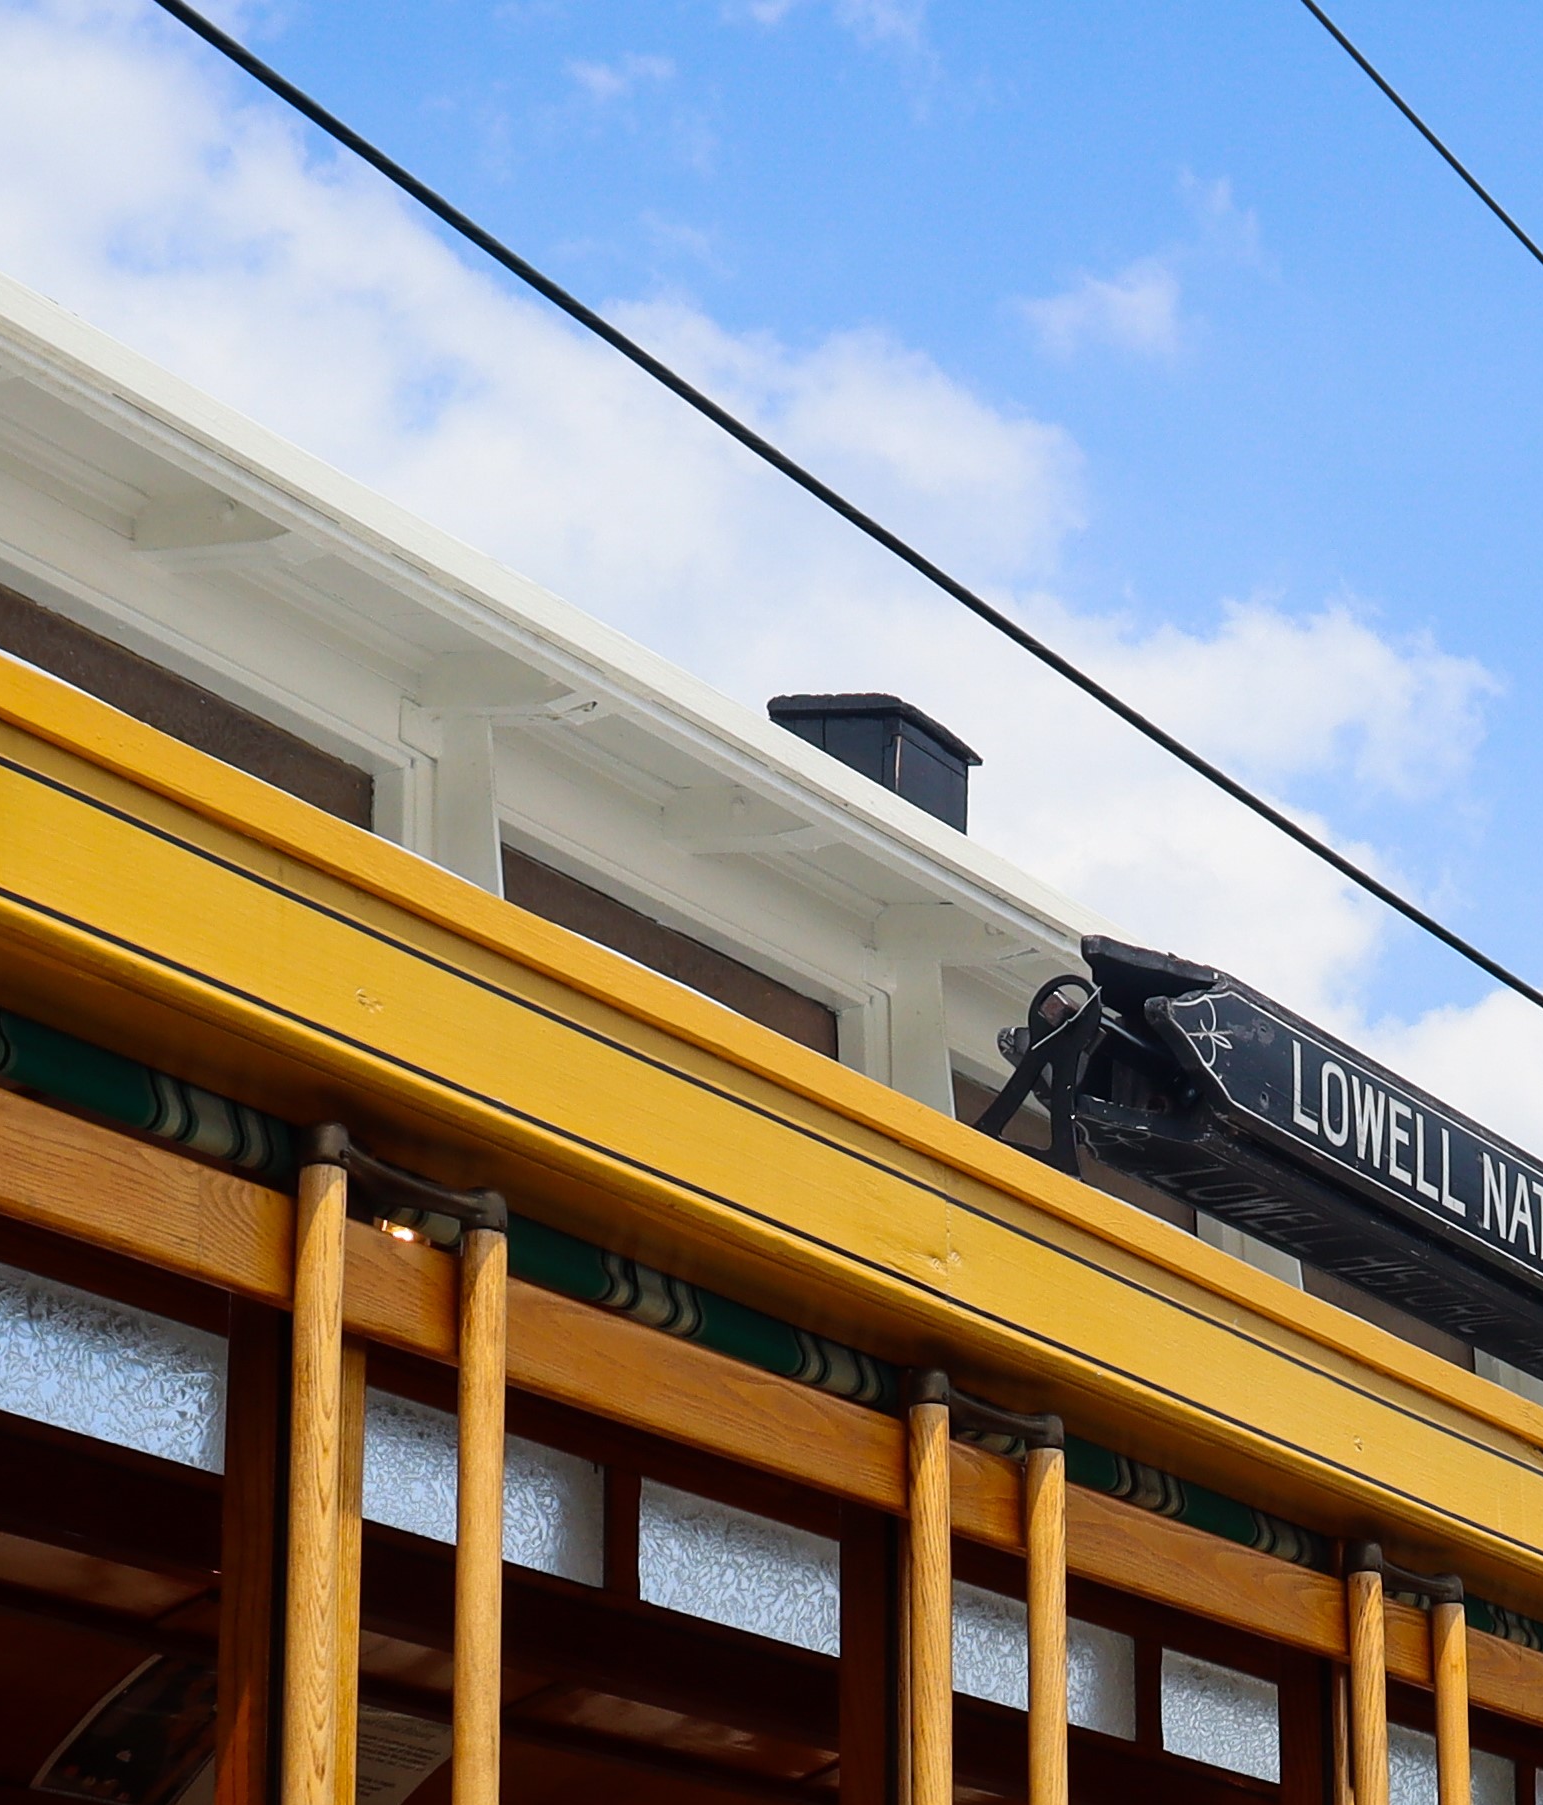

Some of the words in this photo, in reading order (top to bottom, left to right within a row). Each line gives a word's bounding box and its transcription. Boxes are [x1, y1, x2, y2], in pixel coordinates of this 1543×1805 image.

[1290, 1040, 1466, 1216] LOWELL
[1152, 1164, 1361, 1253] LOWELL
[1332, 1254, 1513, 1336] HISTORIC
